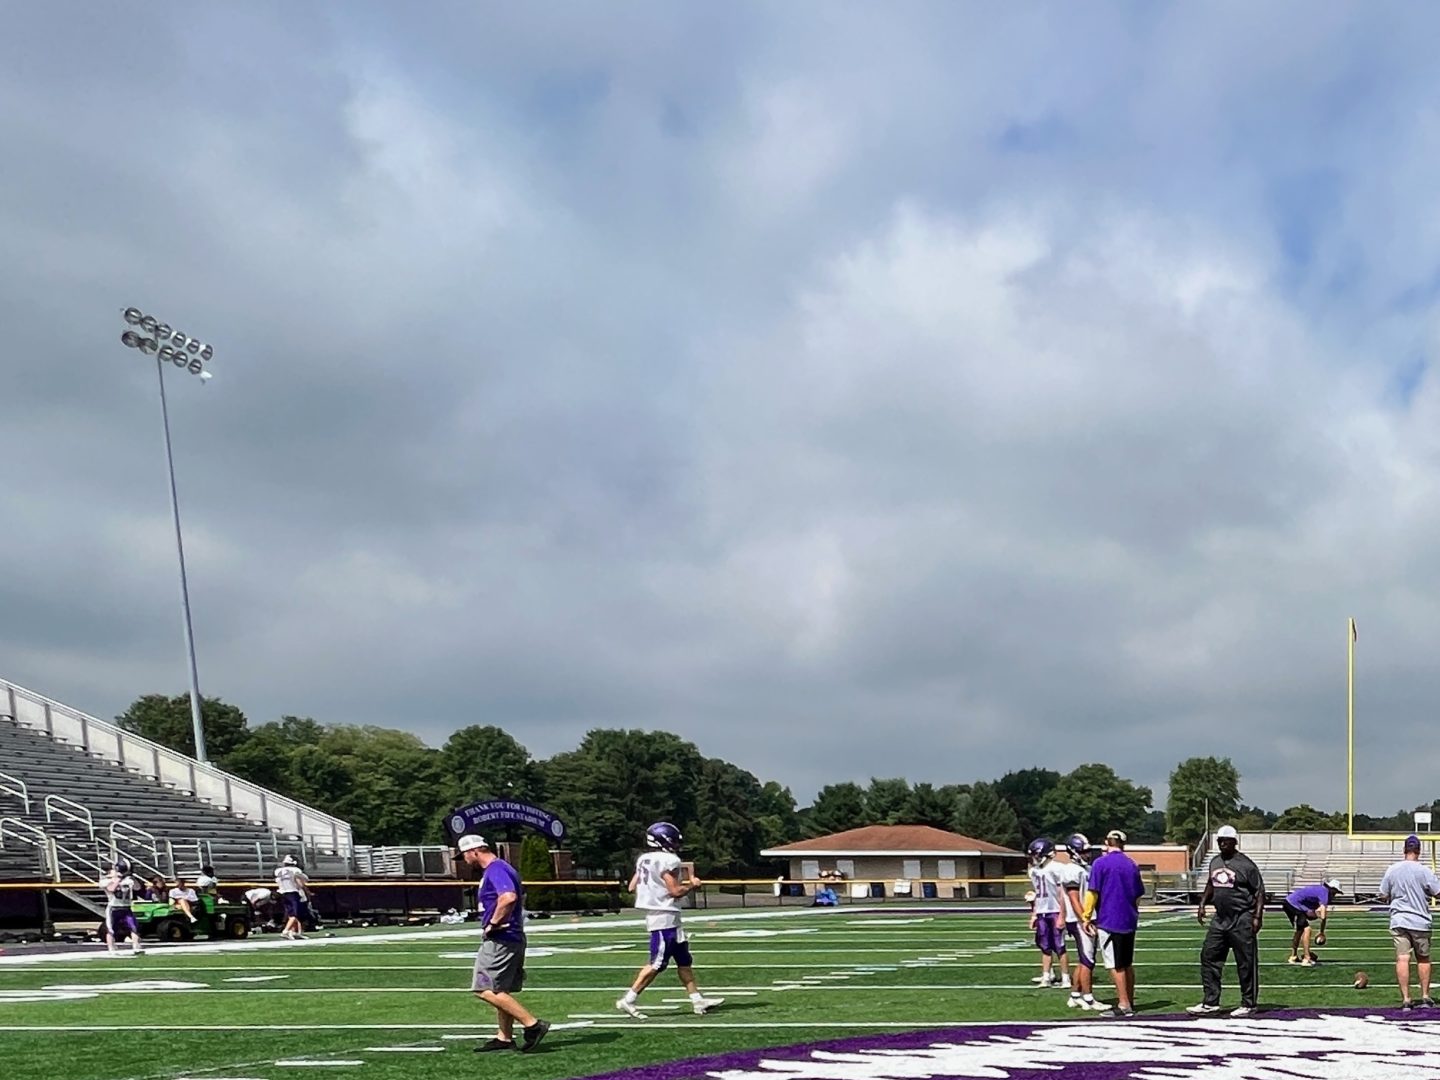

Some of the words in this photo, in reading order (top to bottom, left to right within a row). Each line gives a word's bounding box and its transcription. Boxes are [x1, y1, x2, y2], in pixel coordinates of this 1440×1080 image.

[464, 804, 489, 817] THANK
[506, 802, 521, 810] FOR
[521, 804, 551, 822] VISITING
